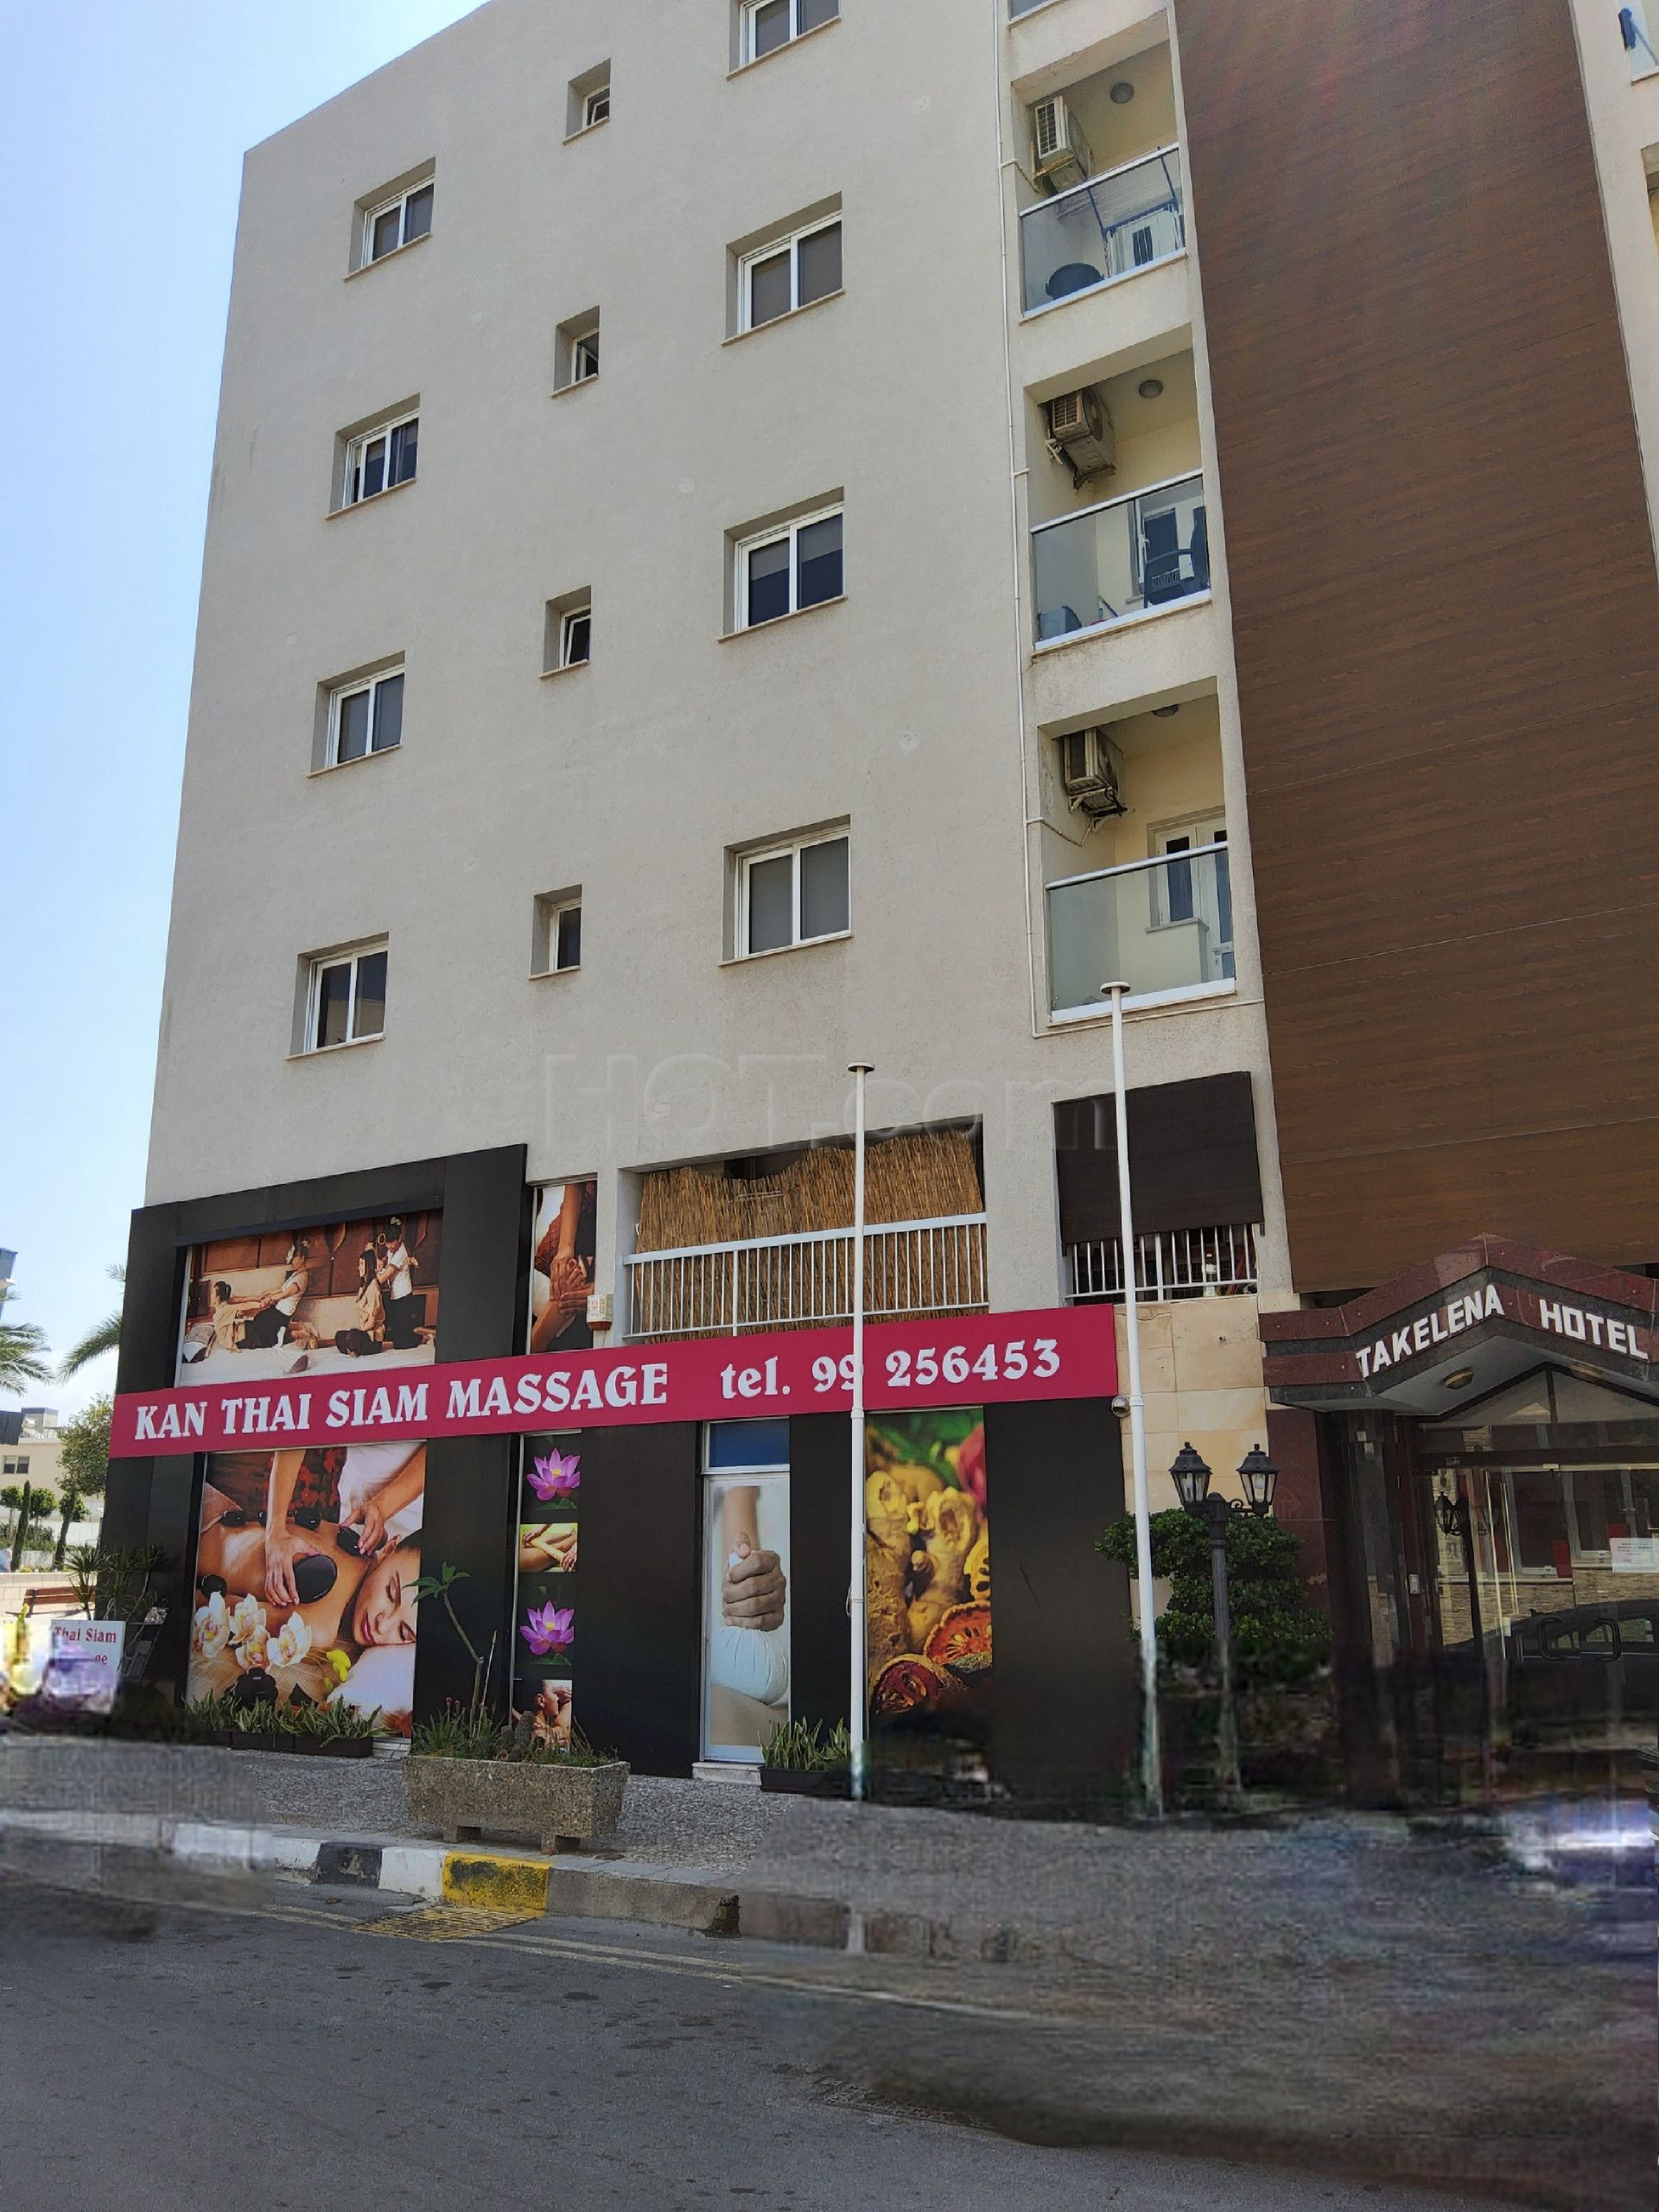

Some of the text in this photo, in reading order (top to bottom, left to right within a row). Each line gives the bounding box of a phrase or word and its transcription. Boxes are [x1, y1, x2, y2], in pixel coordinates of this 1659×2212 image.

[1356, 1284, 1649, 1378] TAKELENA HOTEL
[134, 1338, 1060, 1440] KAN THAI SIAM MASSAGE tel. 99 256453
[86, 1628, 117, 1643] Siam
